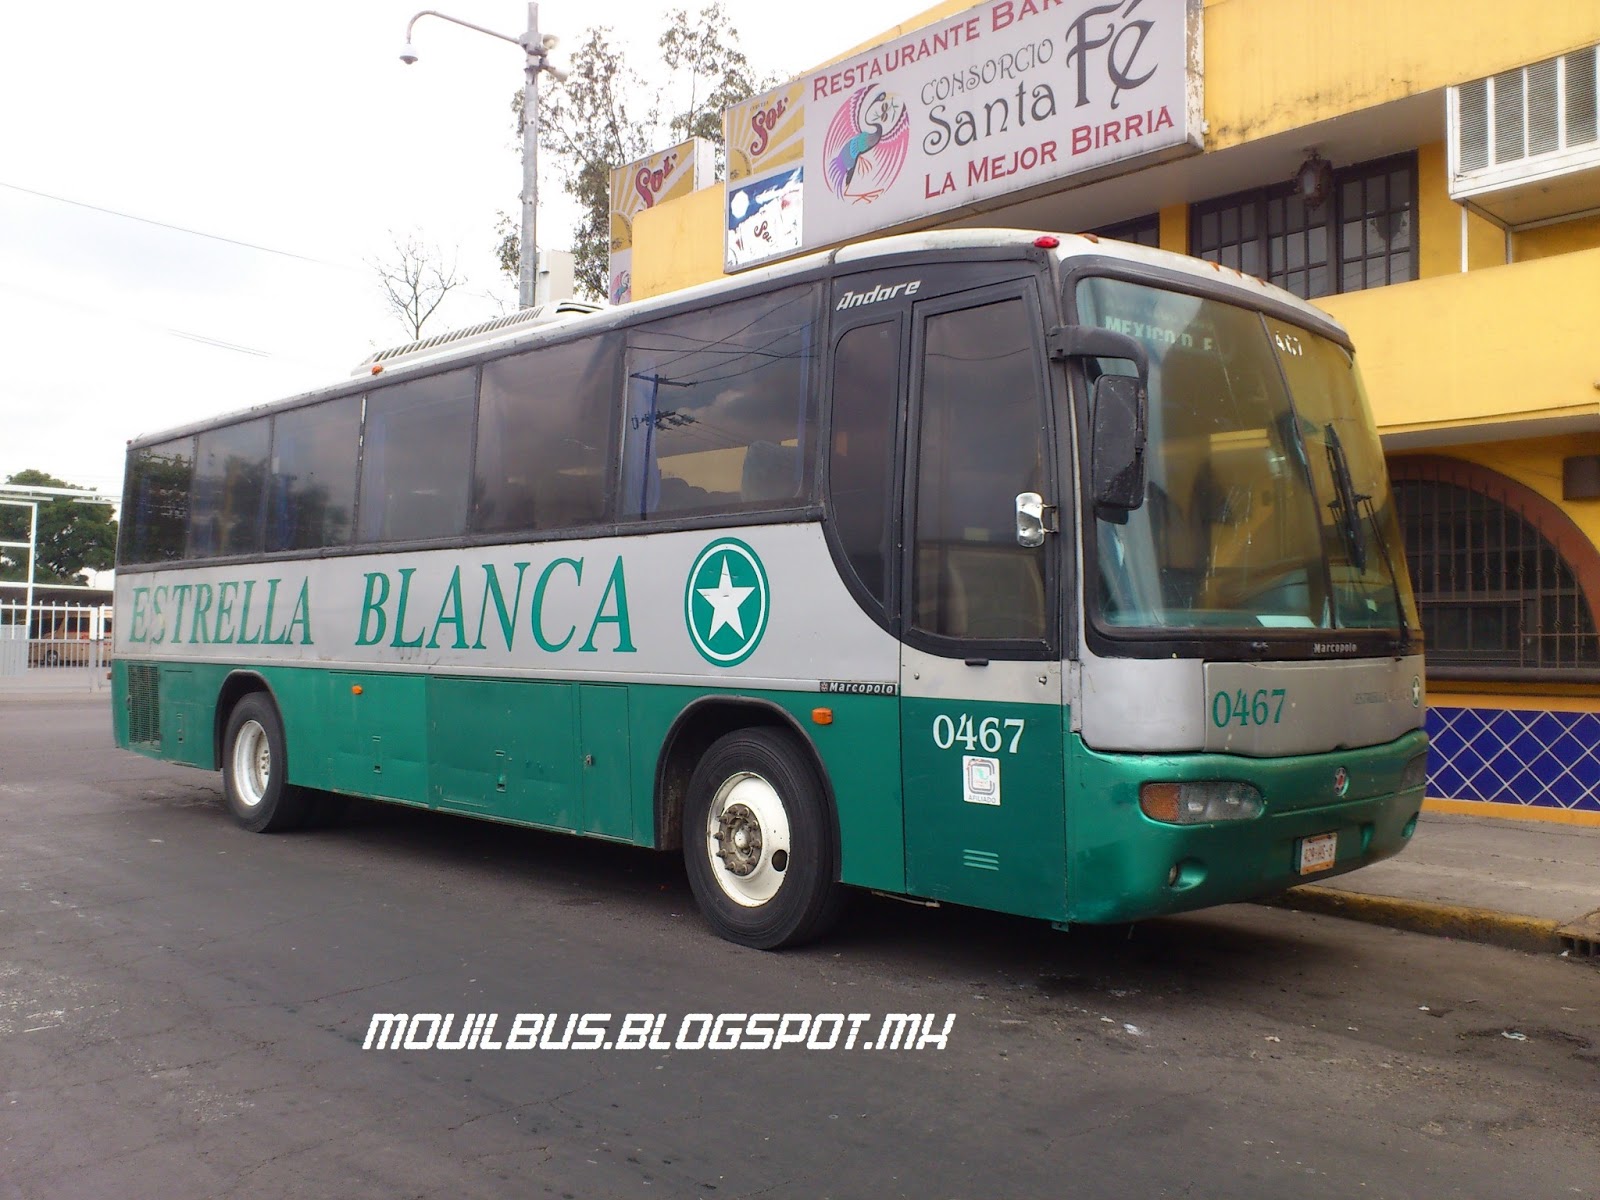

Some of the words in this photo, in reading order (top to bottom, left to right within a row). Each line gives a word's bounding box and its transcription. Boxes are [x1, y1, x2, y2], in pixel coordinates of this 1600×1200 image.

[813, 16, 981, 102] RESTAURANTE
[921, 38, 1054, 105] CONSORCIO
[923, 80, 1057, 156] Santa
[1065, 0, 1159, 110] Fé
[925, 171, 957, 199] LA
[967, 140, 1058, 187] MEJOR
[1071, 105, 1175, 156] BIRRIA
[836, 280, 921, 311] Andare
[128, 575, 315, 646] ESTRELLA
[354, 555, 639, 654] BLANCA
[1313, 642, 1358, 654] Marcopolo
[829, 682, 895, 695] Marcopolo
[1212, 688, 1287, 728] 0467
[932, 713, 1026, 754] 0467
